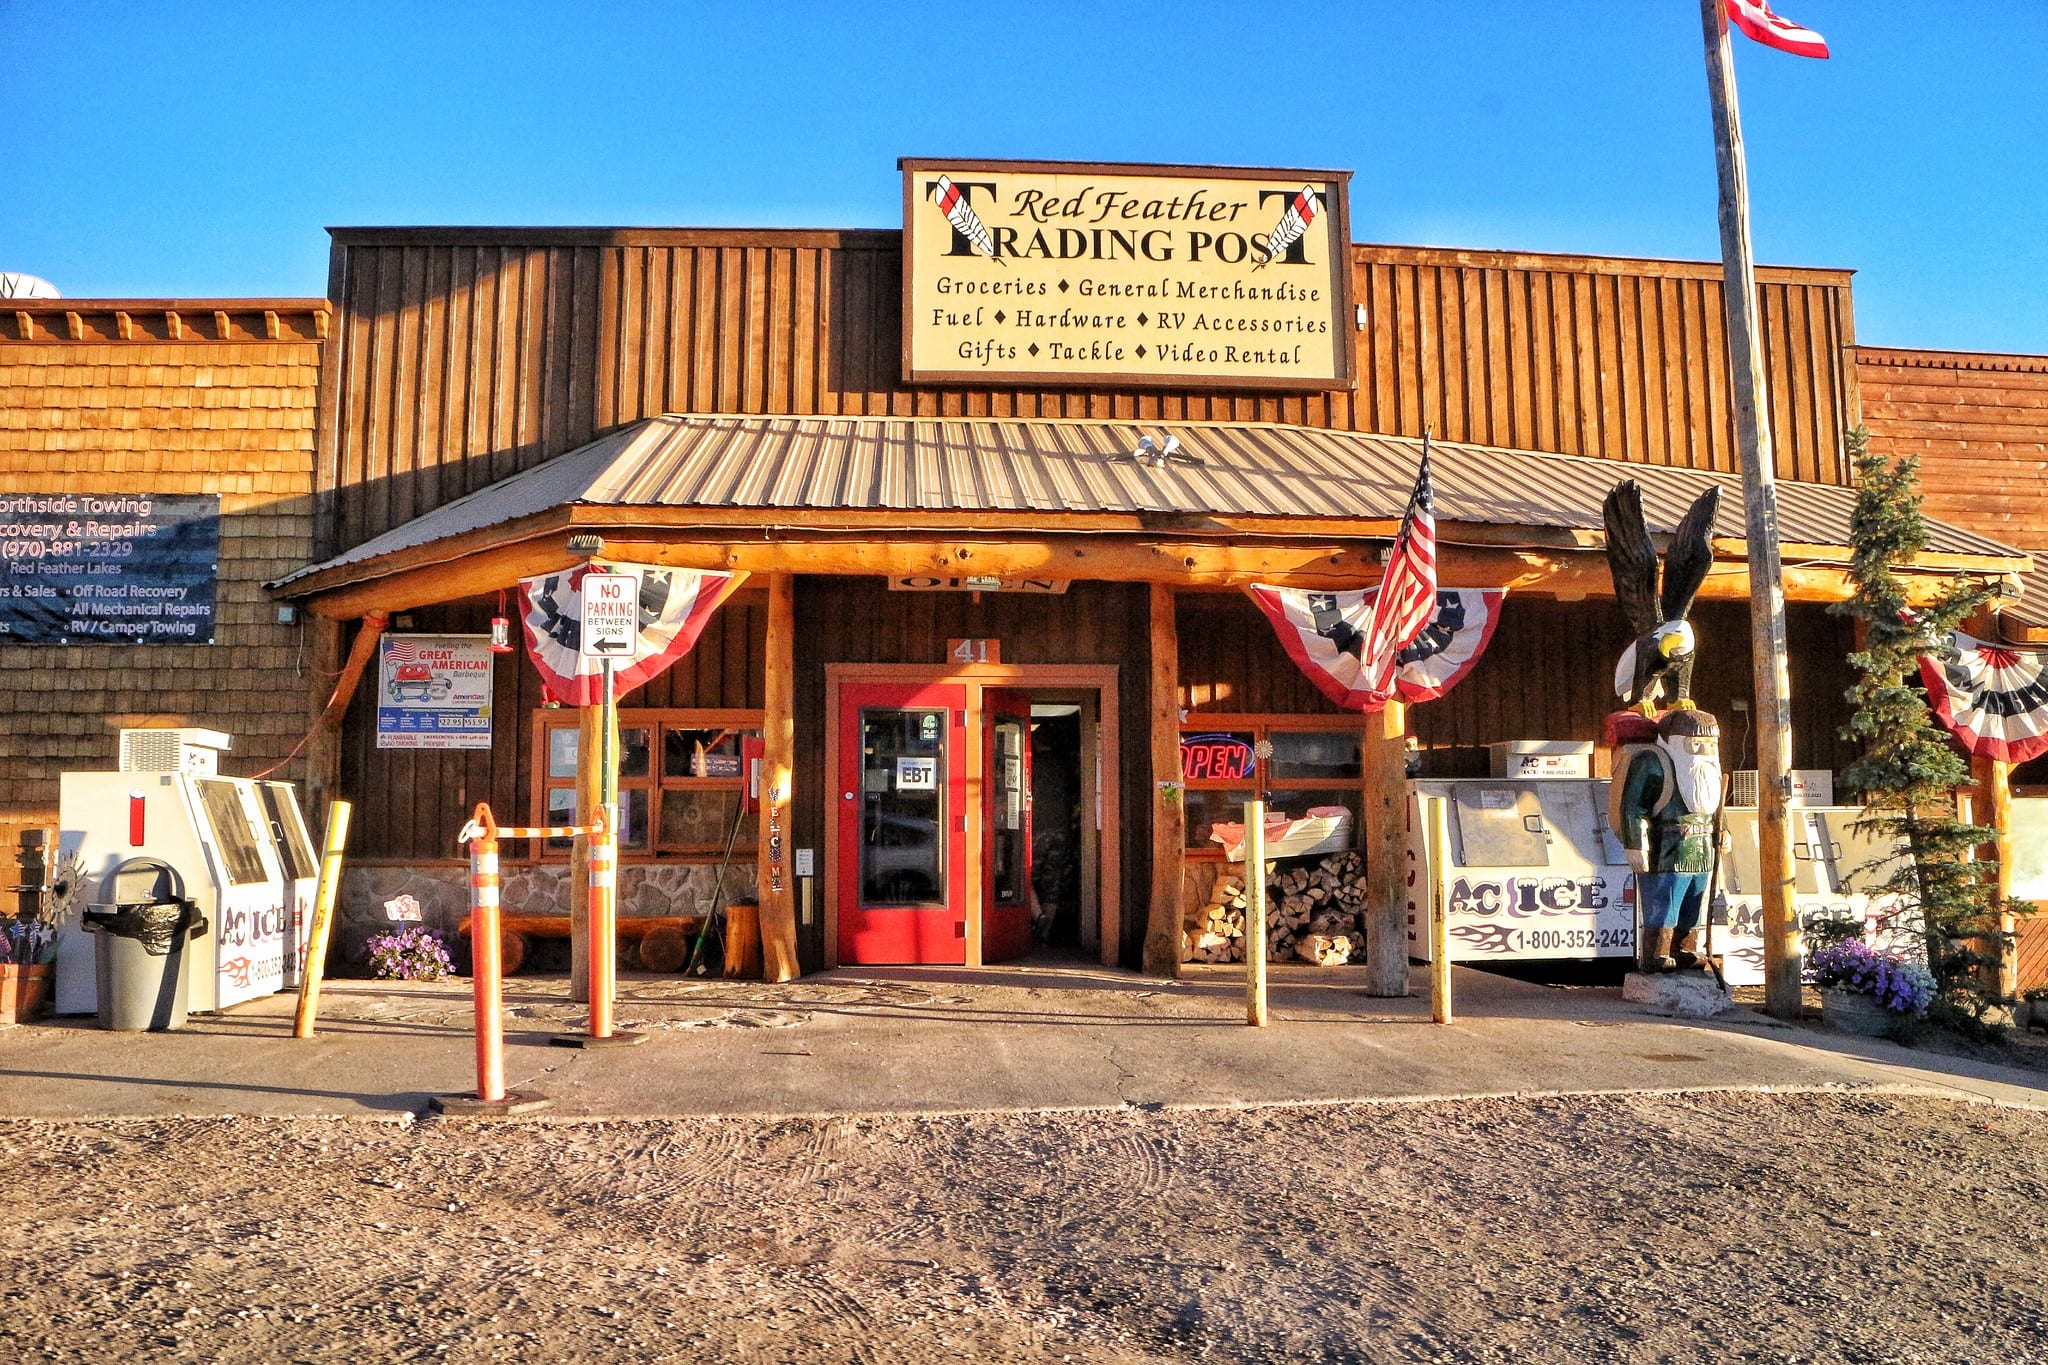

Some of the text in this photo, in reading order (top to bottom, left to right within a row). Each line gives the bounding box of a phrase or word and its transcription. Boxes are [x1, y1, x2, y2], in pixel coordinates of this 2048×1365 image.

[1009, 186, 1247, 223] Red Feather
[926, 182, 1327, 265] TRADING POST
[937, 277, 1320, 301] Groceries General Merchandise
[932, 307, 1327, 333] Fuel Hardware RV Accessories
[958, 342, 1302, 366] Gifts Tackle Video Rental
[81, 498, 152, 516] Towing
[66, 521, 81, 536] &
[86, 522, 156, 540] Repairs
[2, 541, 133, 559] (970)-881-2329
[10, 562, 122, 574] Red Feather Lakes
[900, 576, 1054, 590] ON
[12, 585, 22, 597] &
[24, 585, 56, 597] Sales
[73, 585, 187, 600] Off Road Recovery
[601, 584, 620, 598] NO
[72, 603, 210, 617] All Mechanical Repairs
[588, 602, 633, 616] PARKING
[72, 621, 196, 635] RV / Camper Towing
[419, 651, 453, 660] GREAT
[954, 639, 989, 663] 41
[431, 661, 488, 670] AMERICAN
[453, 670, 486, 679] Barbeque
[1521, 756, 1539, 767] AC
[902, 767, 931, 783] EBT
[1449, 877, 1502, 917] AC
[1517, 876, 1608, 912] ICE
[220, 903, 286, 946] AC ICE
